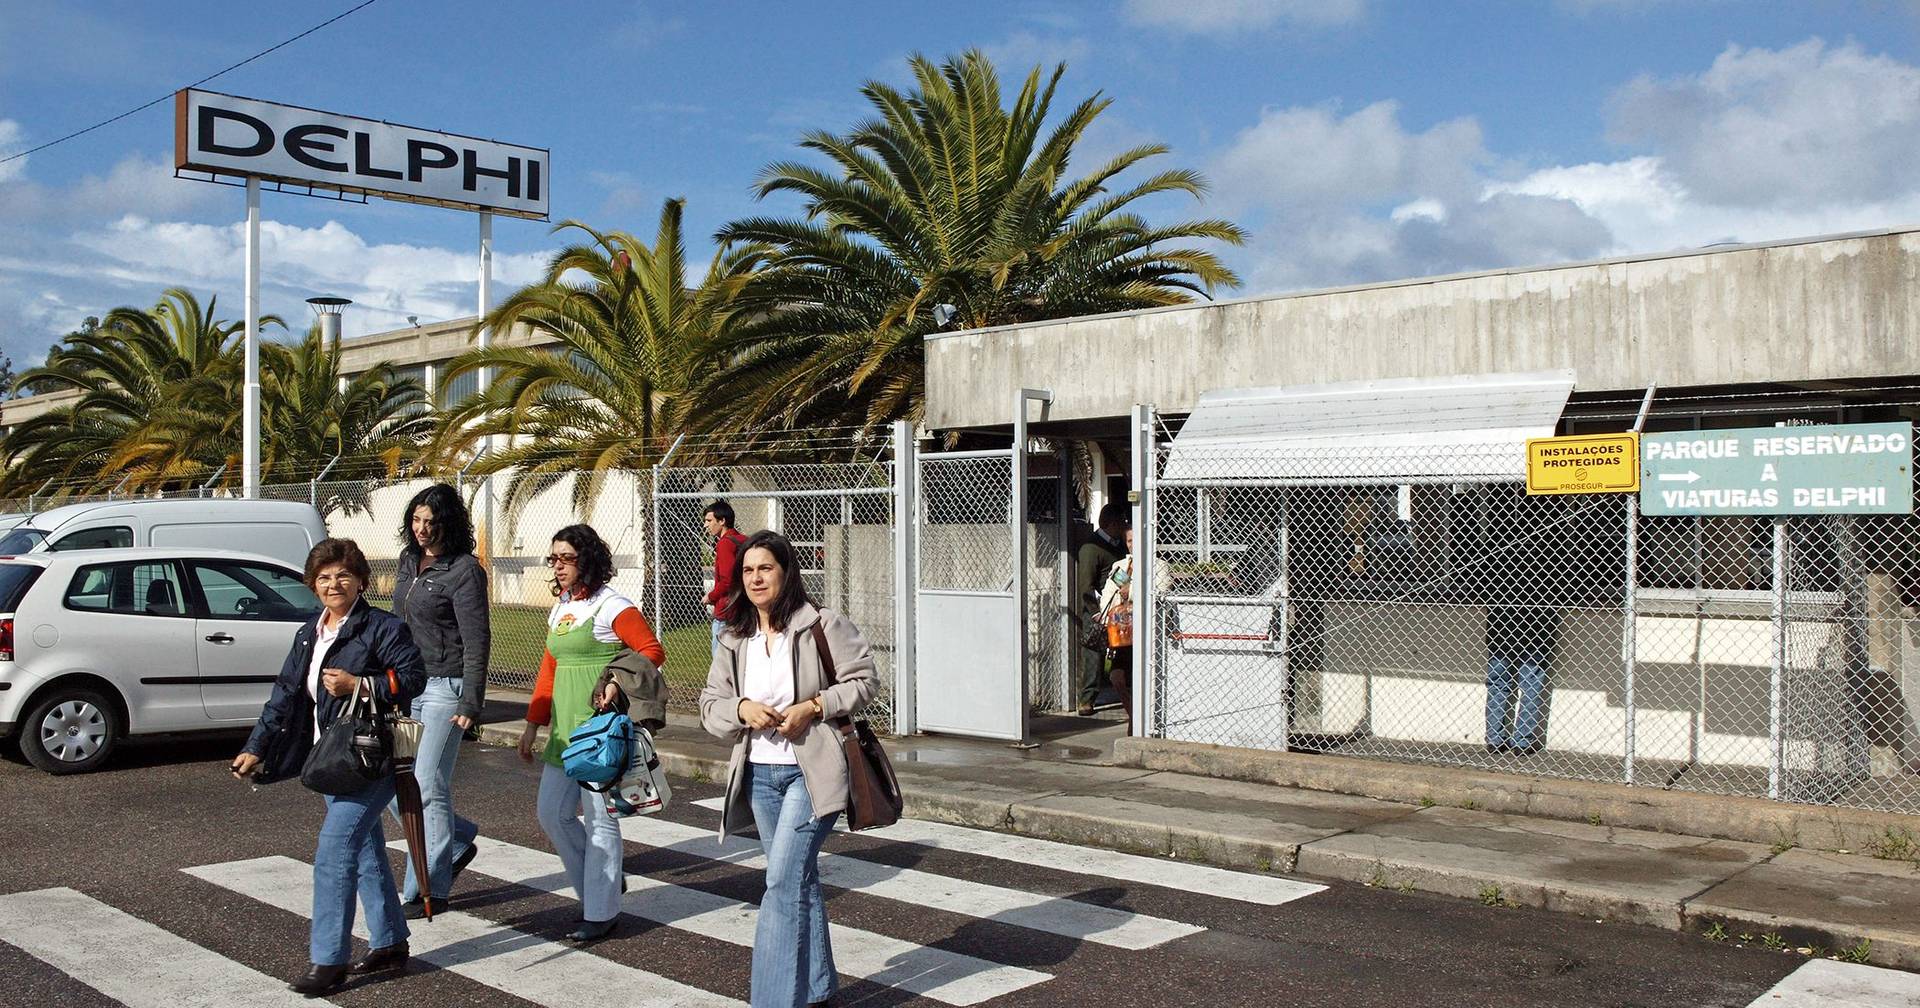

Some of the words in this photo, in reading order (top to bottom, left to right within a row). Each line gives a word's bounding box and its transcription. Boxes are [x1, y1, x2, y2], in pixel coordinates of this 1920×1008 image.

[198, 105, 540, 201] DELPHI
[1646, 439, 1739, 460] PARQUE
[1755, 433, 1905, 457] RESERVADO
[1543, 457, 1621, 468] PROTEGIDAS
[1760, 463, 1778, 482] A
[1560, 482, 1603, 491] PROSEGUR
[1662, 488, 1778, 509] VIATURAS
[1793, 487, 1886, 508] DELPHI
